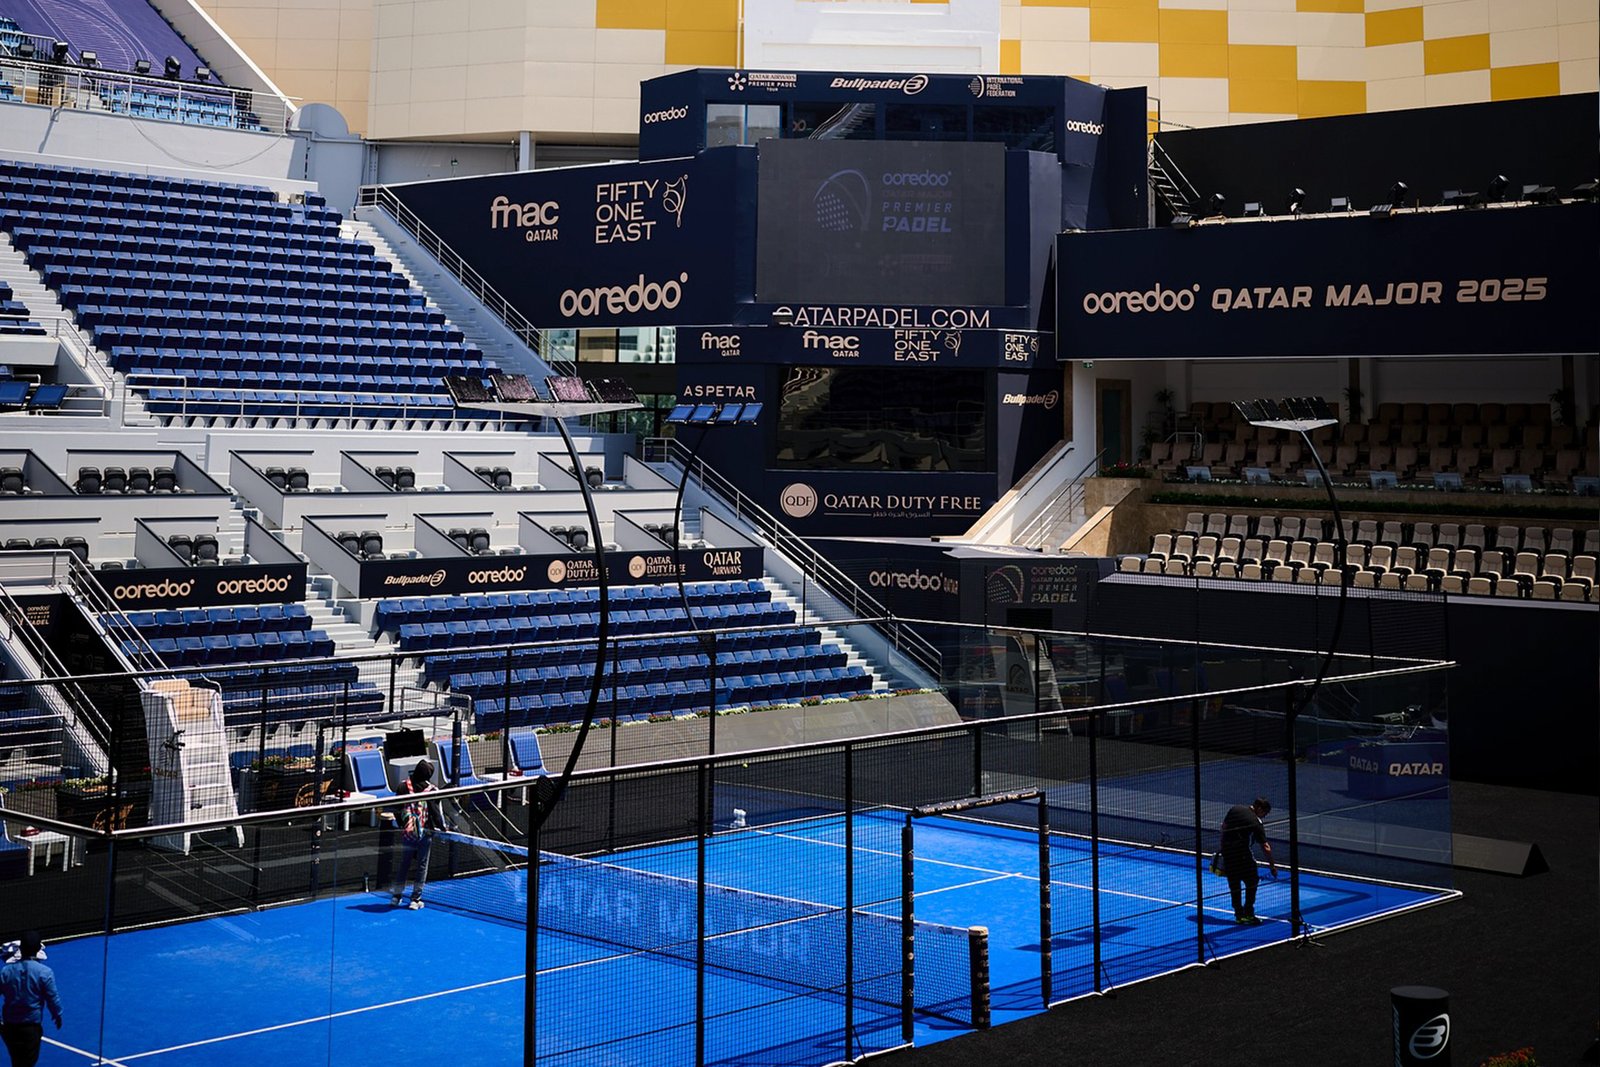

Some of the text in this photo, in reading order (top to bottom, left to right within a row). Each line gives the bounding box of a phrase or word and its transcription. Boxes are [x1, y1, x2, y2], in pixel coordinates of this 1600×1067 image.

[830, 77, 906, 91] Bullpadel
[644, 106, 688, 123] ooredoo
[1066, 120, 1104, 136] ooredoo
[882, 169, 952, 186] ooredoo
[597, 179, 660, 203] FIFTY
[490, 195, 560, 229] fnac
[596, 201, 645, 223] ONE
[882, 202, 952, 212] PREMIER
[882, 216, 951, 232] PADEL
[525, 228, 559, 242] QATAR
[595, 221, 657, 244] EAST
[559, 271, 688, 318] ooredoo
[1083, 277, 1548, 315] ooredoo QATAR MAJOR 2025
[701, 331, 741, 350] fnac
[802, 330, 860, 349] fnac
[894, 330, 942, 340] FIFTY
[1005, 334, 1030, 344] FIFTY
[894, 340, 931, 351] ONE
[1005, 343, 1025, 352] ONE
[721, 349, 741, 357] QATAR
[832, 350, 860, 358] QATAR
[894, 351, 941, 361] EAST
[1005, 352, 1029, 361] EAST
[683, 385, 756, 400] ASPETAR
[1003, 393, 1045, 406] Bullpadel
[785, 495, 813, 507] QDF
[824, 493, 981, 510] QATAR DUTY FREE
[567, 559, 594, 570] QATAR
[646, 556, 671, 566] QATAR
[703, 550, 742, 566] QATAR
[467, 565, 527, 584] ooredoo
[566, 568, 590, 579] DUTY
[646, 564, 669, 575] DUTY
[712, 565, 742, 576] AIRWAYS
[1031, 564, 1078, 575] ooredoo
[216, 574, 292, 595] ooredoo
[384, 574, 431, 587] Bullpadel
[869, 568, 944, 591] ooredoo
[114, 578, 195, 600] ooredoo
[1031, 592, 1078, 603] PADEL
[1349, 755, 1379, 774] QATAR
[1388, 762, 1444, 777] QATAR
